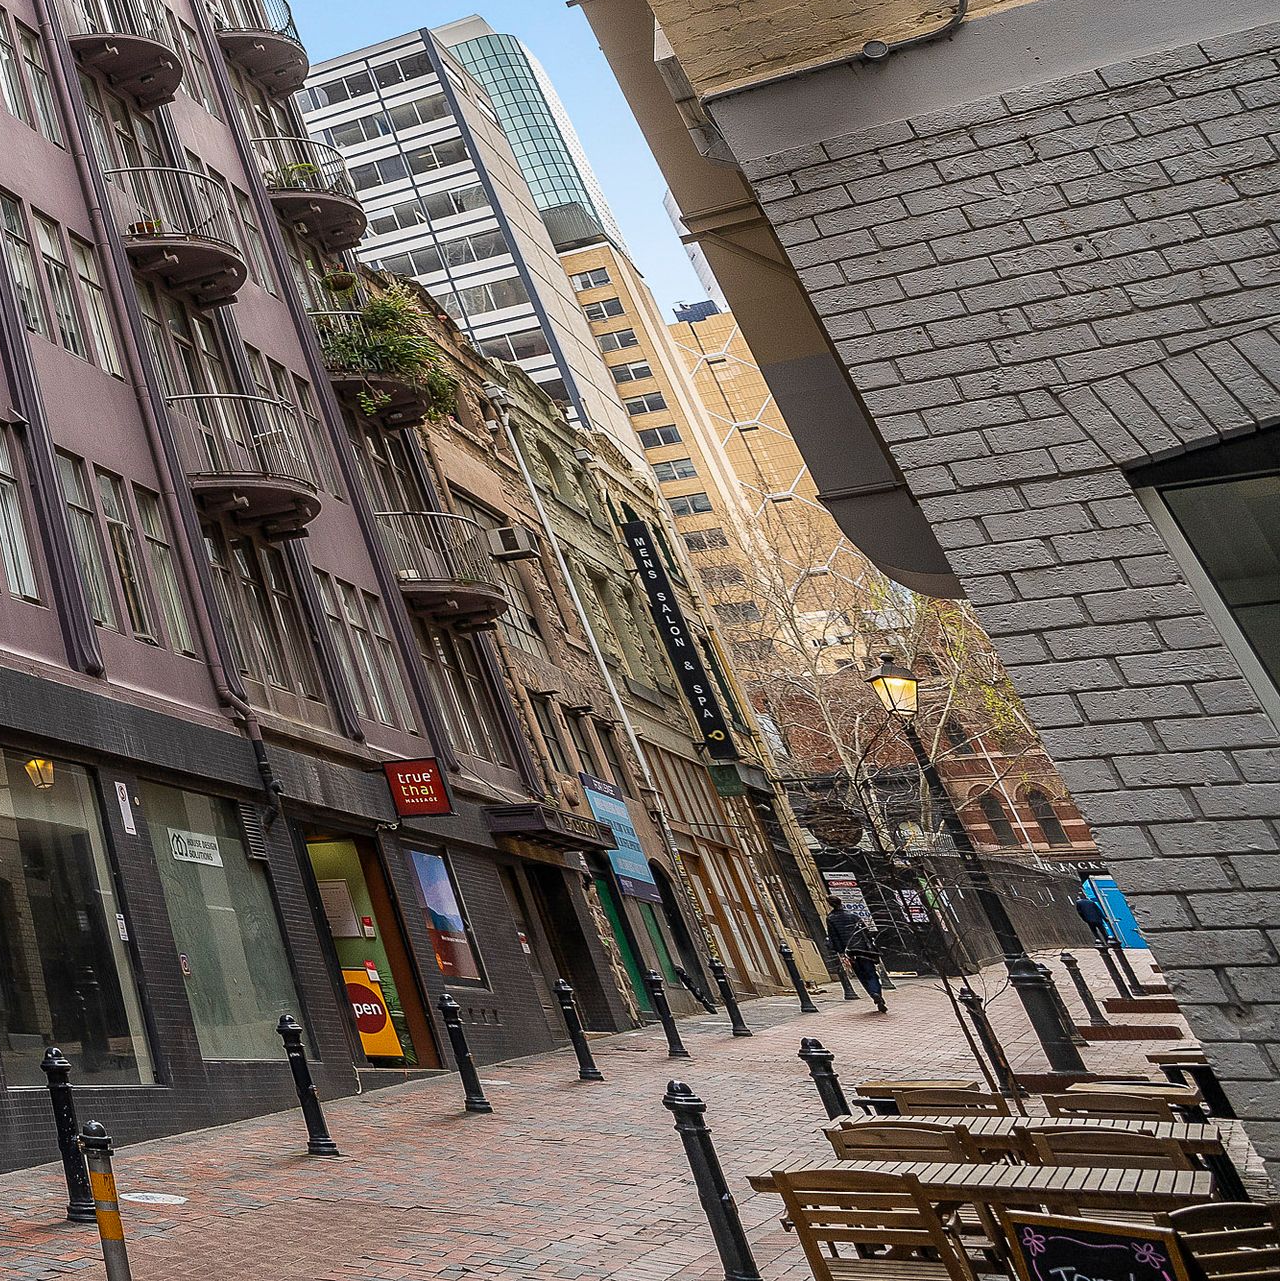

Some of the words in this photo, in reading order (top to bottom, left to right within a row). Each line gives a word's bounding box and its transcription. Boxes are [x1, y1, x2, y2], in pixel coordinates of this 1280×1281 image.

[633, 537, 658, 579] MENS
[656, 592, 686, 648] SALON
[683, 661, 694, 671] &
[693, 684, 714, 718] SPA
[397, 772, 431, 784] true
[401, 785, 434, 796] thai
[187, 838, 202, 848] HOUSE
[201, 840, 218, 851] DESIGN
[188, 849, 214, 861] SOLUTIONS
[353, 1001, 383, 1018] pen
